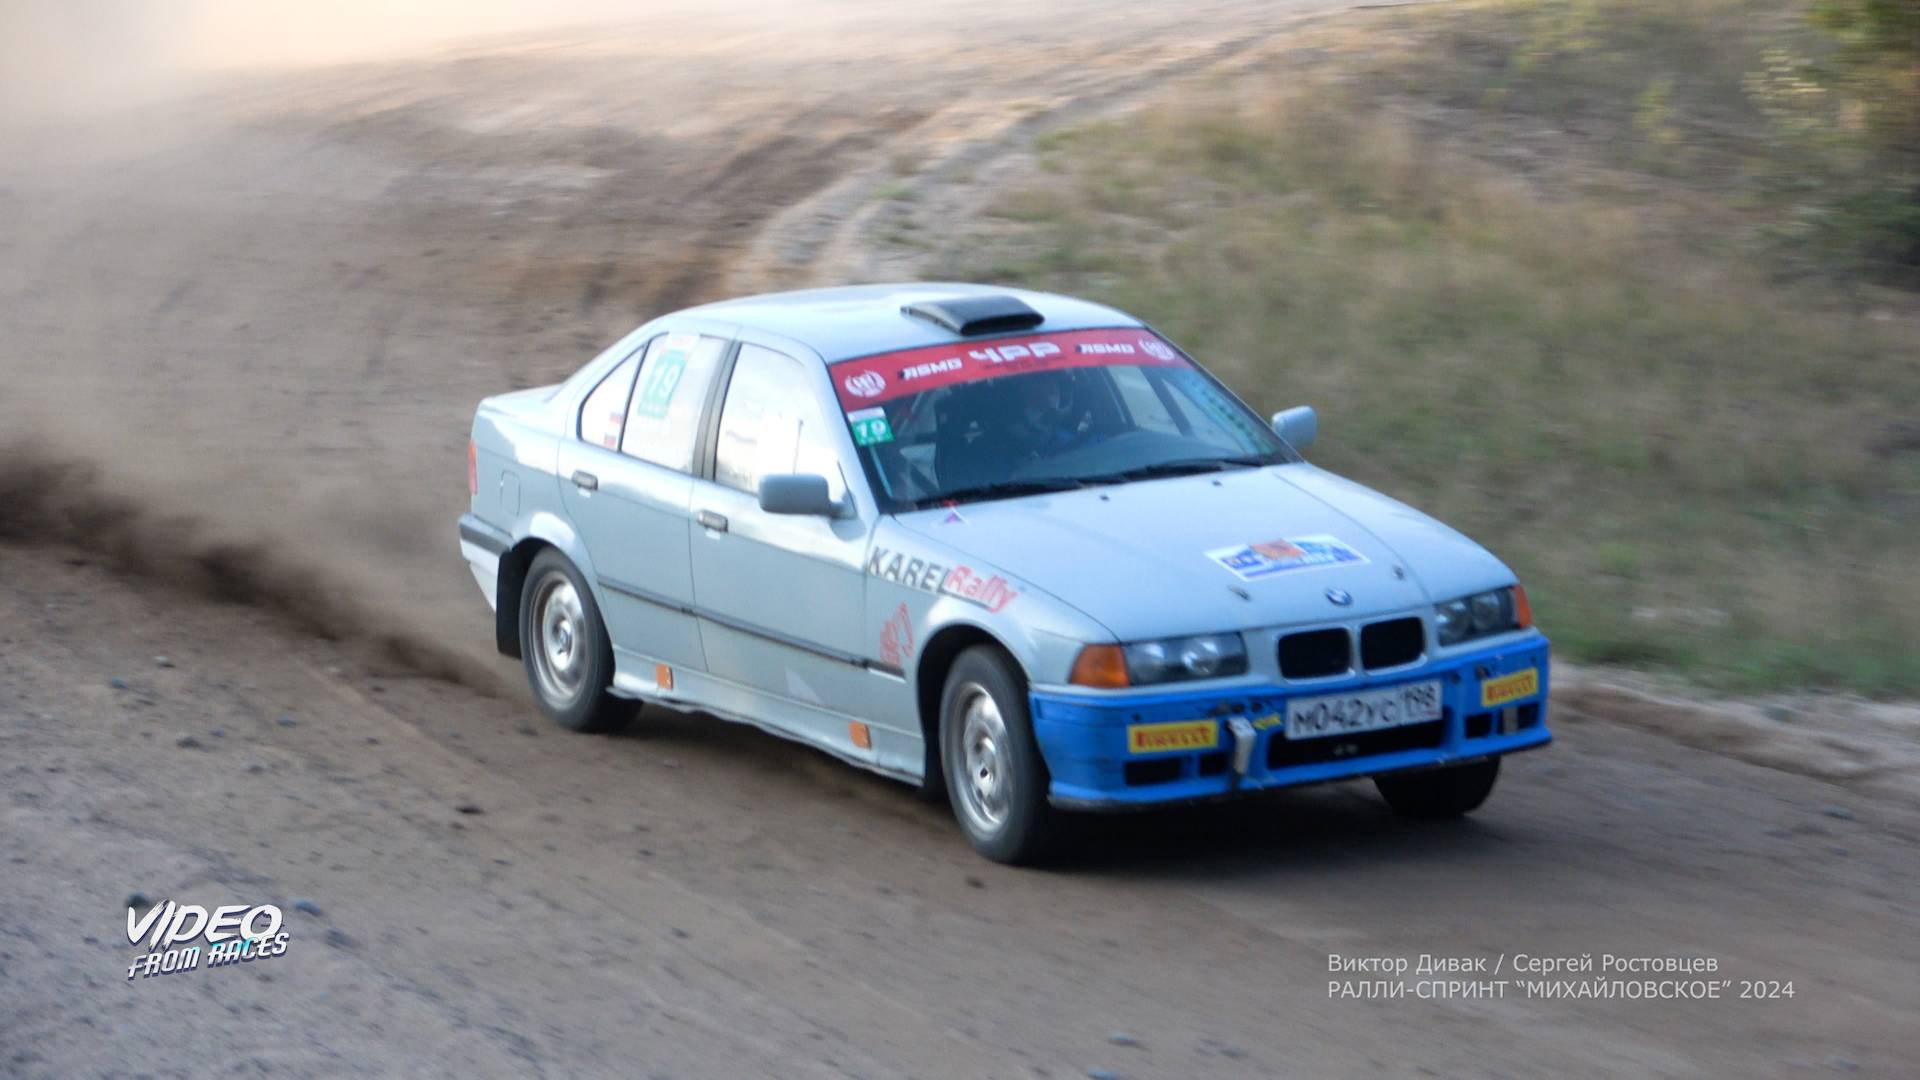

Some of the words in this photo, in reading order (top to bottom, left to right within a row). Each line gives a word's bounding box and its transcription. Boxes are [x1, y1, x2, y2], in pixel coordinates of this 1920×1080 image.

[651, 363, 681, 396] 19
[856, 419, 887, 437] 19
[868, 546, 950, 595] KAREL
[945, 564, 1018, 613] Rally
